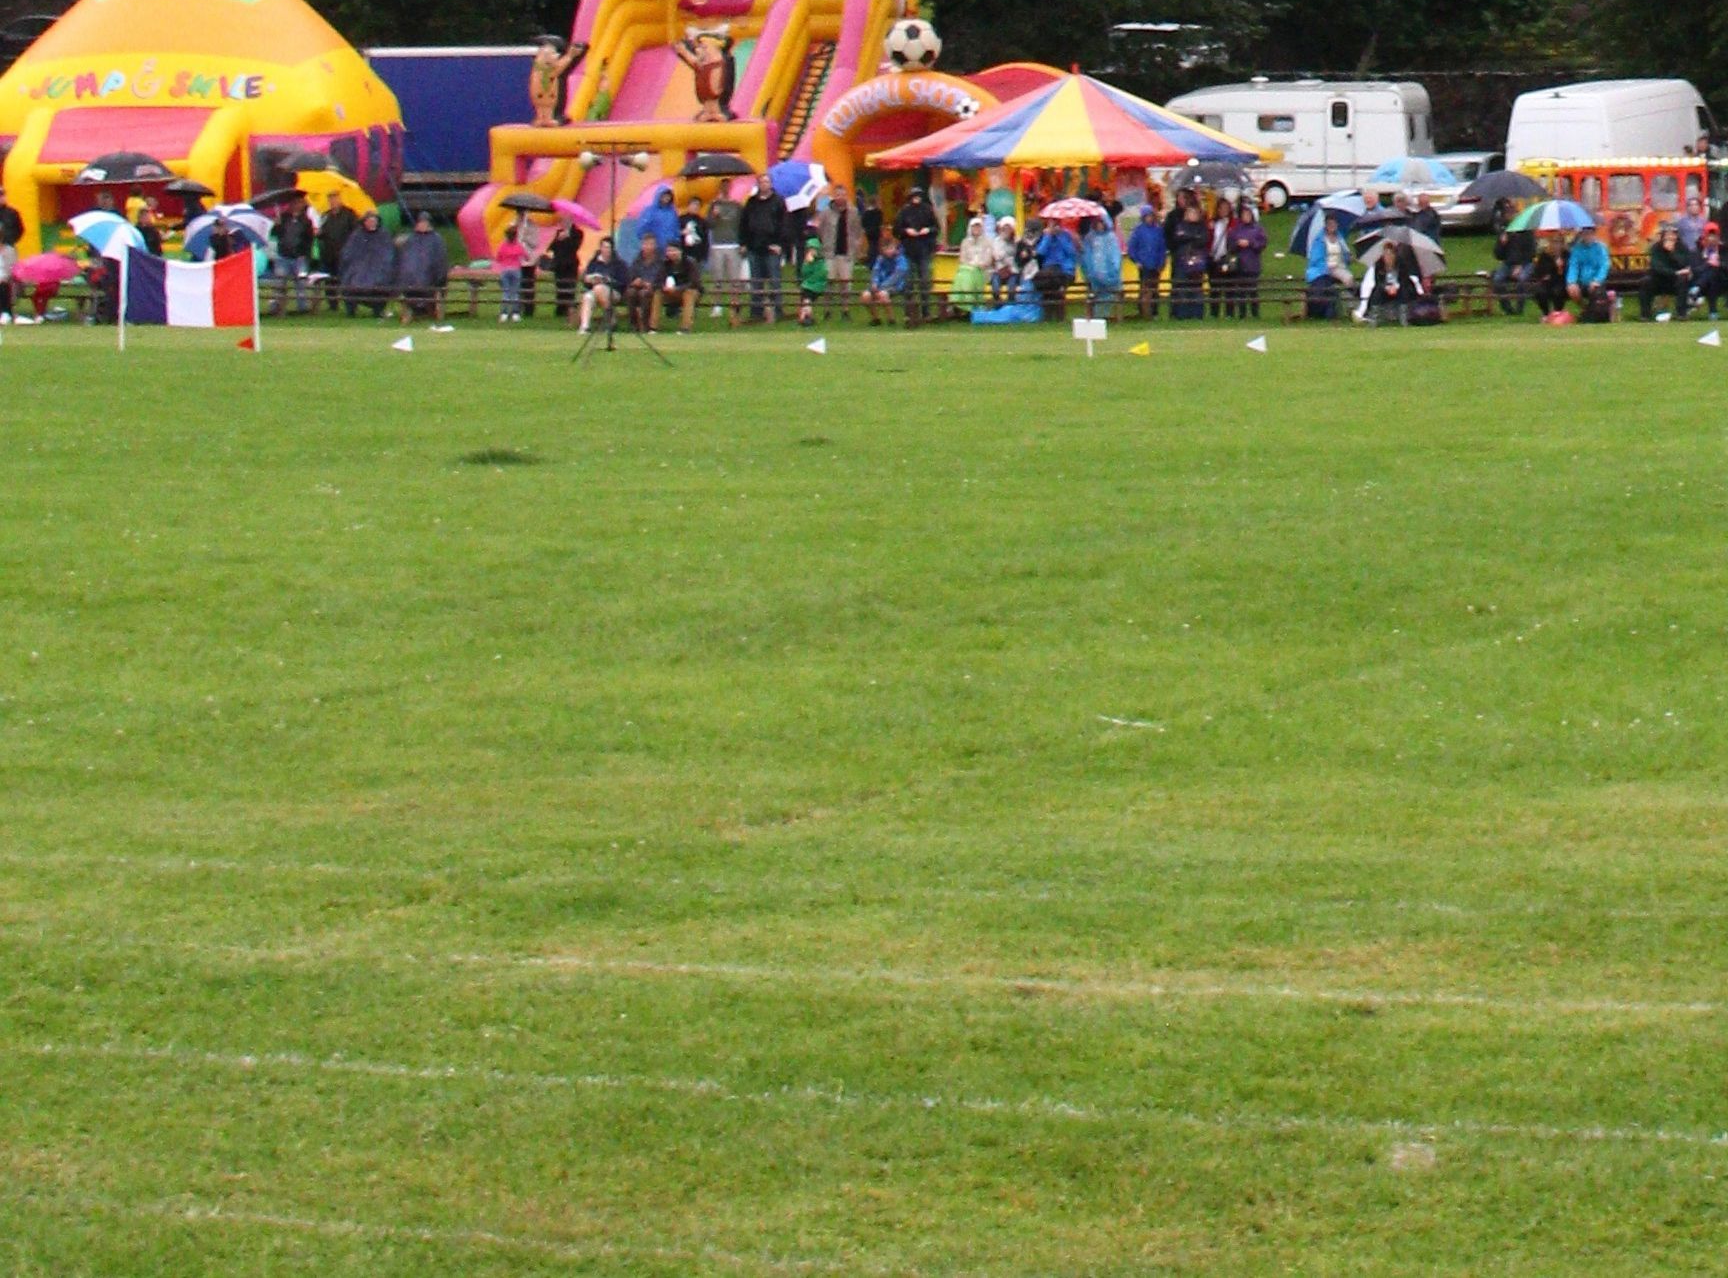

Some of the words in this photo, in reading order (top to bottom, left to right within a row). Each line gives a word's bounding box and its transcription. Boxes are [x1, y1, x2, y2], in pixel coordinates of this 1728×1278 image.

[29, 70, 126, 100] JUMP
[169, 71, 264, 101] SMILE
[823, 79, 905, 137] FOOTBALL
